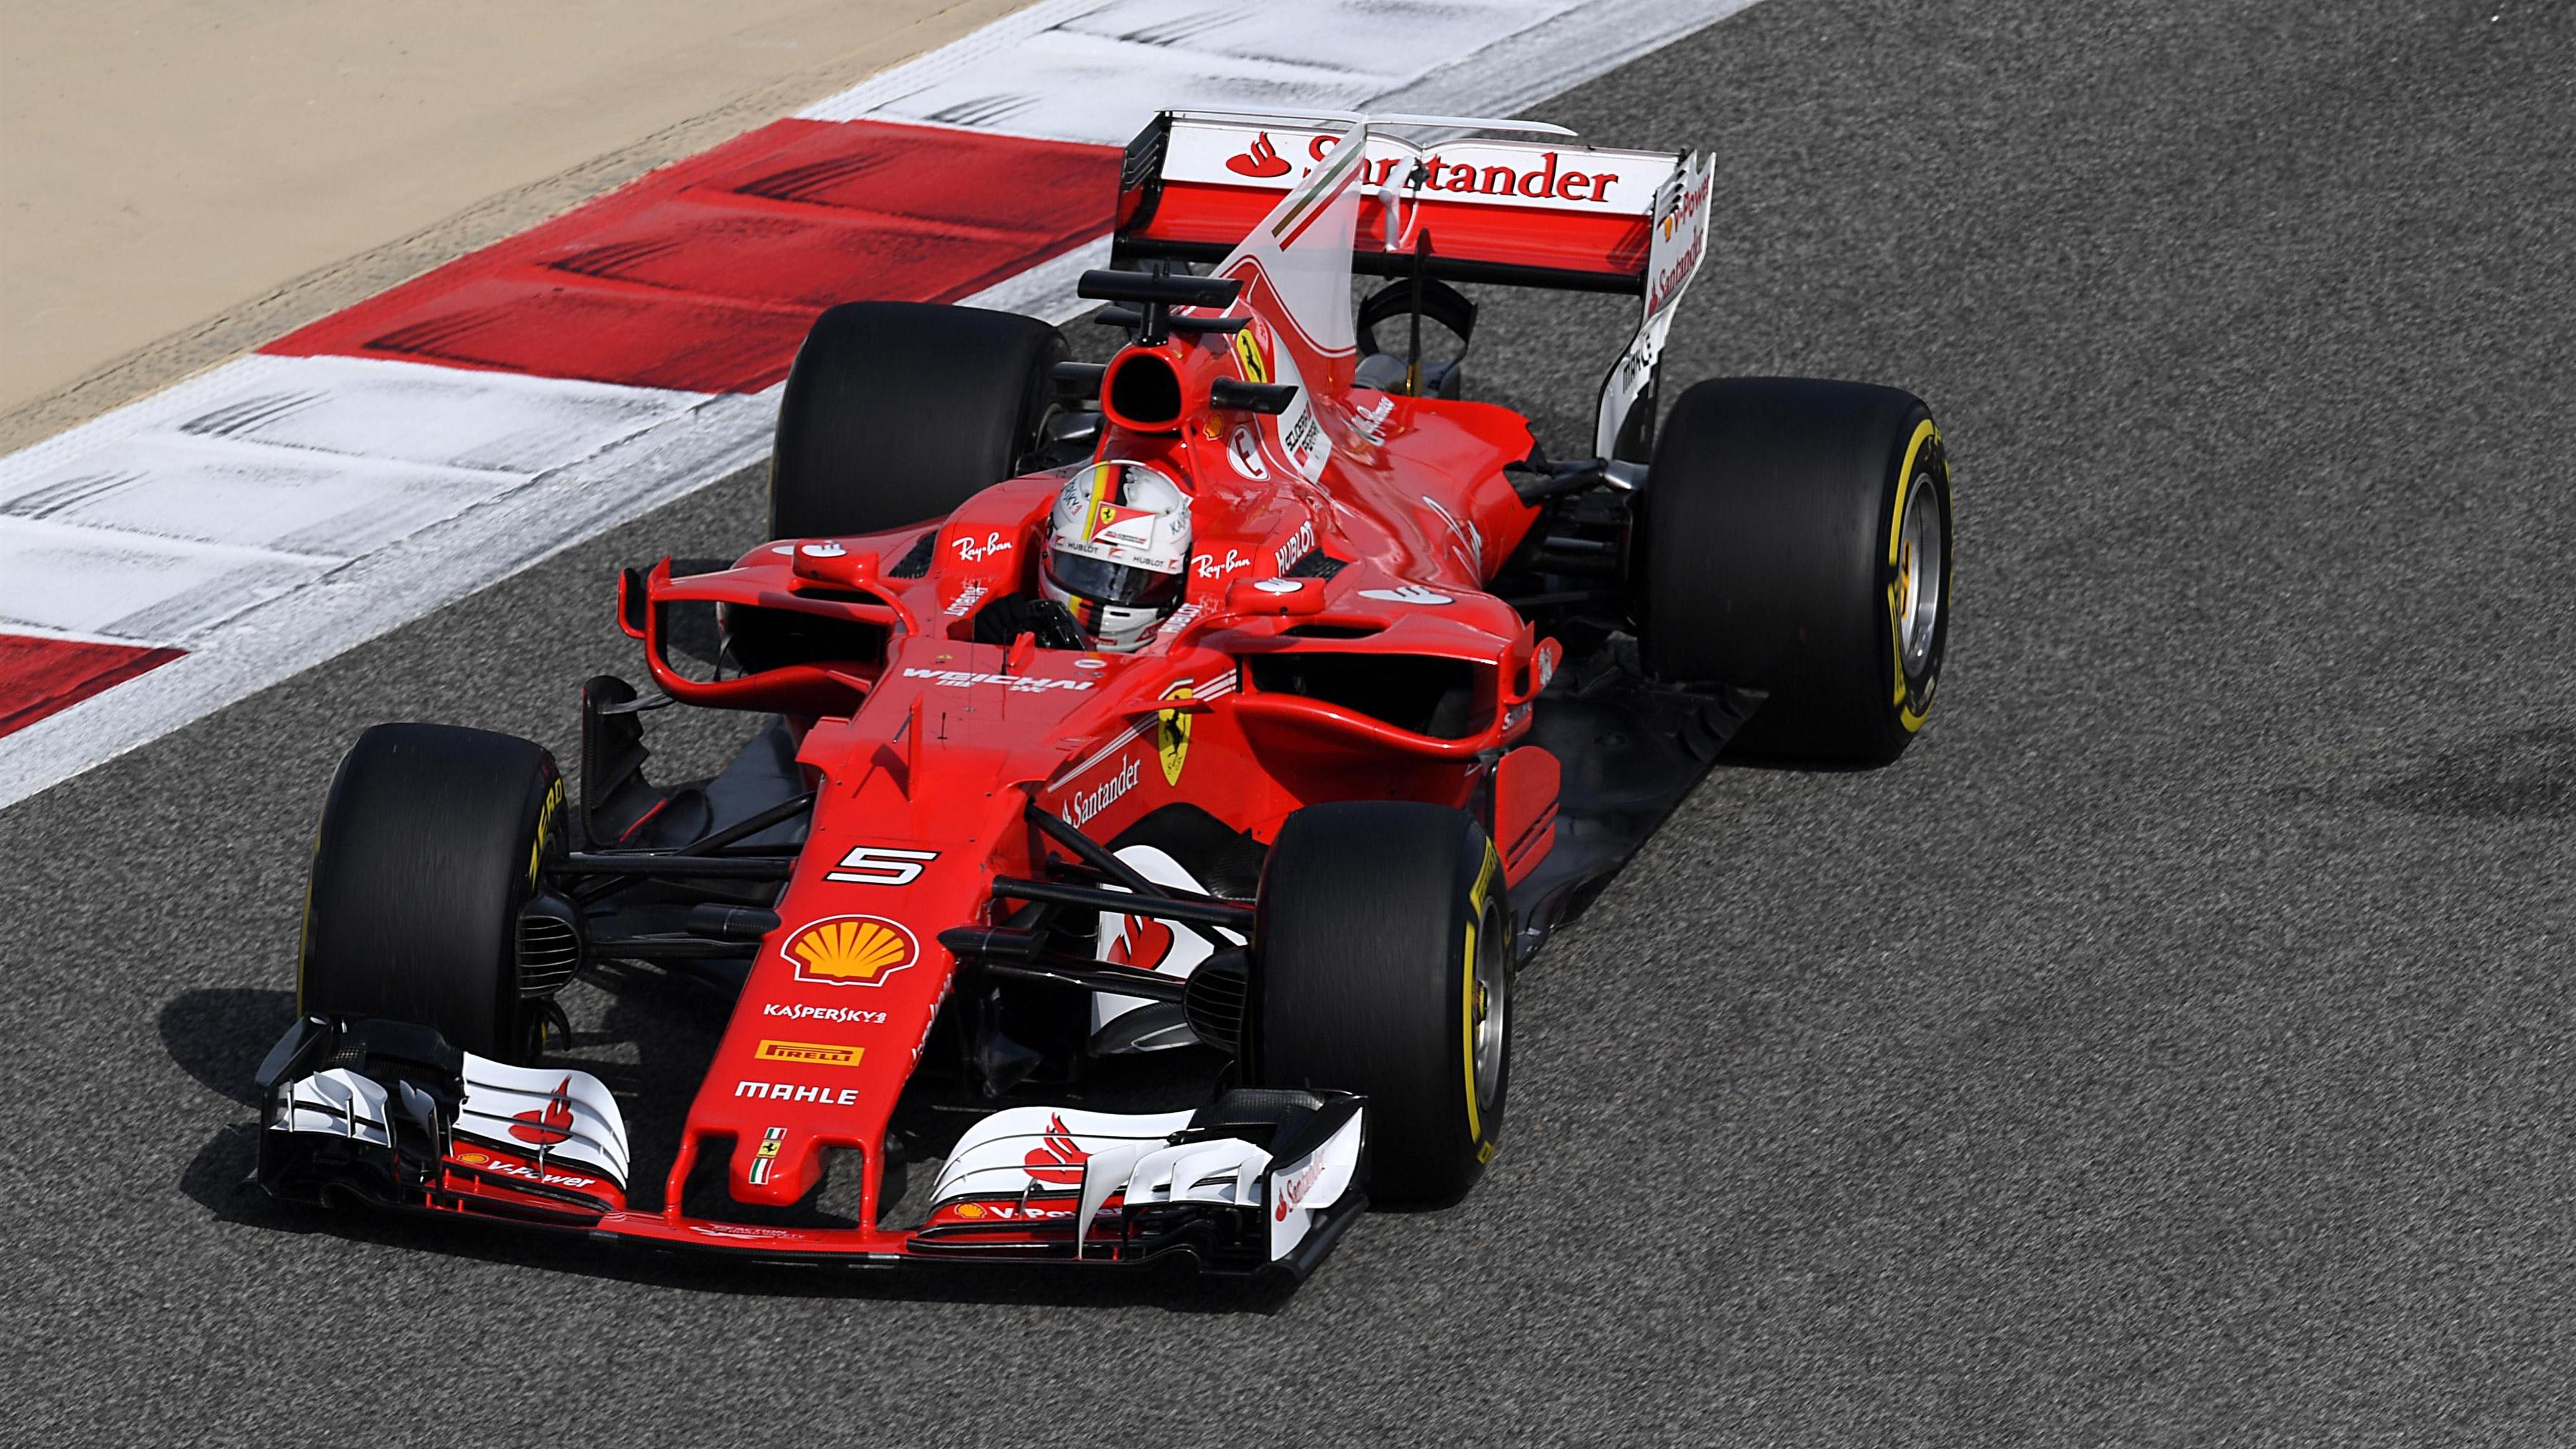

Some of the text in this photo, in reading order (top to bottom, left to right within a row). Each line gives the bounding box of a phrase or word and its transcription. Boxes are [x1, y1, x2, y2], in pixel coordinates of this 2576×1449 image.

[1659, 225, 1704, 299] Santander
[1068, 542, 1098, 554] HUBLOT
[1274, 520, 1314, 578] HUBLOT
[1133, 556, 1164, 567] HUBLOT
[903, 668, 1094, 691] WEICHAI
[1073, 753, 1141, 830] Santander
[824, 847, 942, 886] 5
[763, 1003, 878, 1023] KASPERSKY
[766, 1044, 854, 1062] PIRELLI
[734, 1080, 859, 1106] MAHLE
[487, 1160, 595, 1188] V-Power
